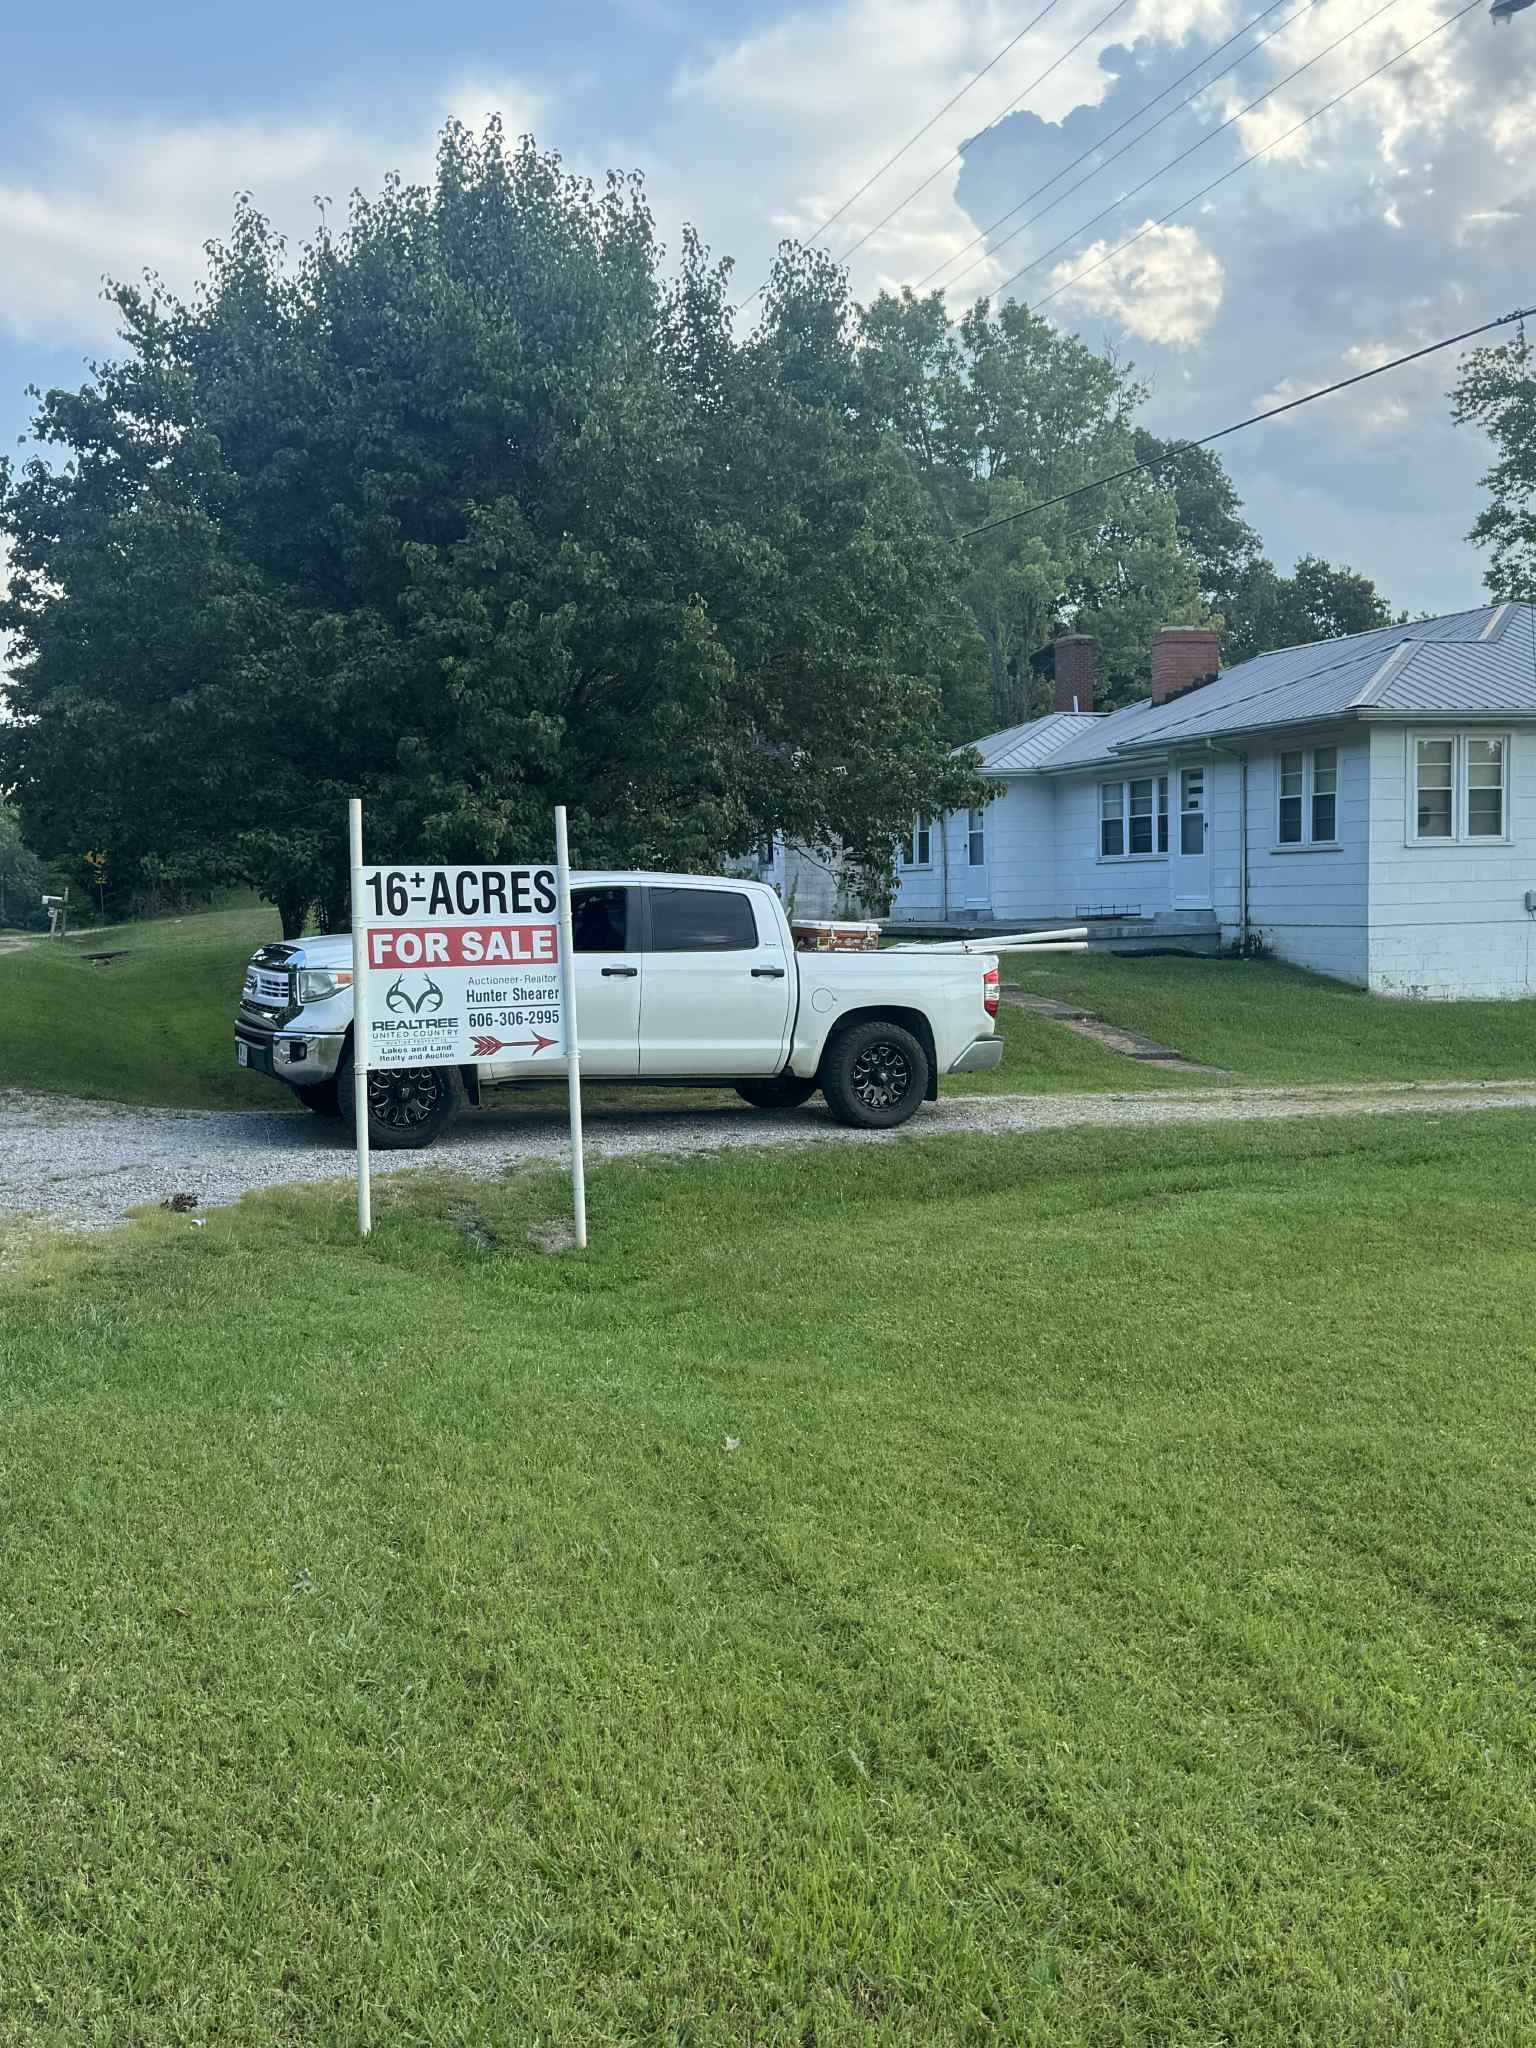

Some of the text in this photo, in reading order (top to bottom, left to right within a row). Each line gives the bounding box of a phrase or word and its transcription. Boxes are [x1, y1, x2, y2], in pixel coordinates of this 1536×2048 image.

[428, 870, 557, 915] ACRES
[372, 930, 554, 964] FOR SALE
[466, 987, 560, 1003] Hunter Shearer
[372, 1018, 459, 1031] REALTREE
[469, 1010, 560, 1027] 606-306-2995
[372, 1029, 458, 1039] UNITED COUNTRY
[411, 1045, 427, 1053] and
[430, 1044, 453, 1052] Land
